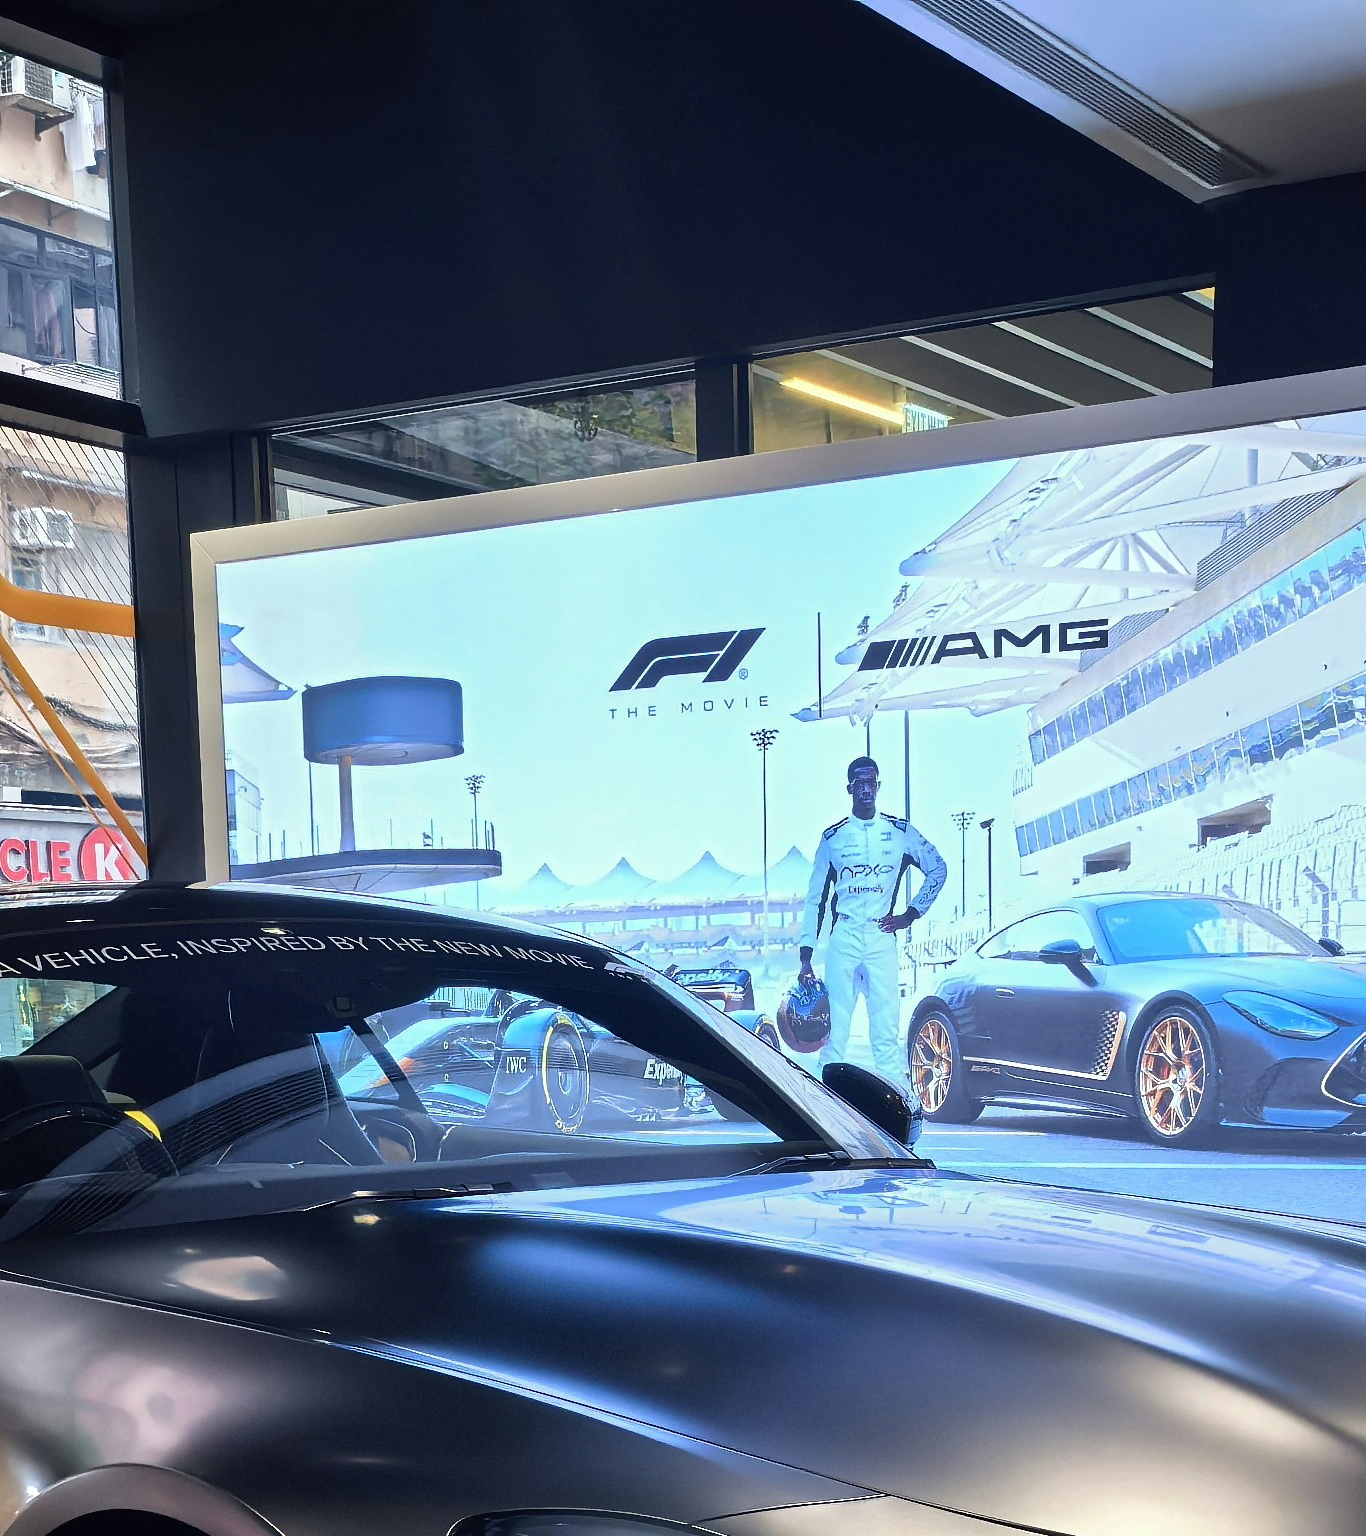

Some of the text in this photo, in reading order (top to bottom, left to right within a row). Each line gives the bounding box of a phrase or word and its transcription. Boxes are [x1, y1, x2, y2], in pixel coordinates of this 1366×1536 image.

[609, 695, 770, 720] THE MOVIE
[17, 941, 179, 973] VEHICLE,
[176, 936, 327, 957] INSPIRED
[326, 936, 372, 951] BY
[369, 936, 437, 954] THE
[433, 939, 505, 959] NEW
[502, 945, 595, 970] MOVIE
[505, 1056, 527, 1074] IWC
